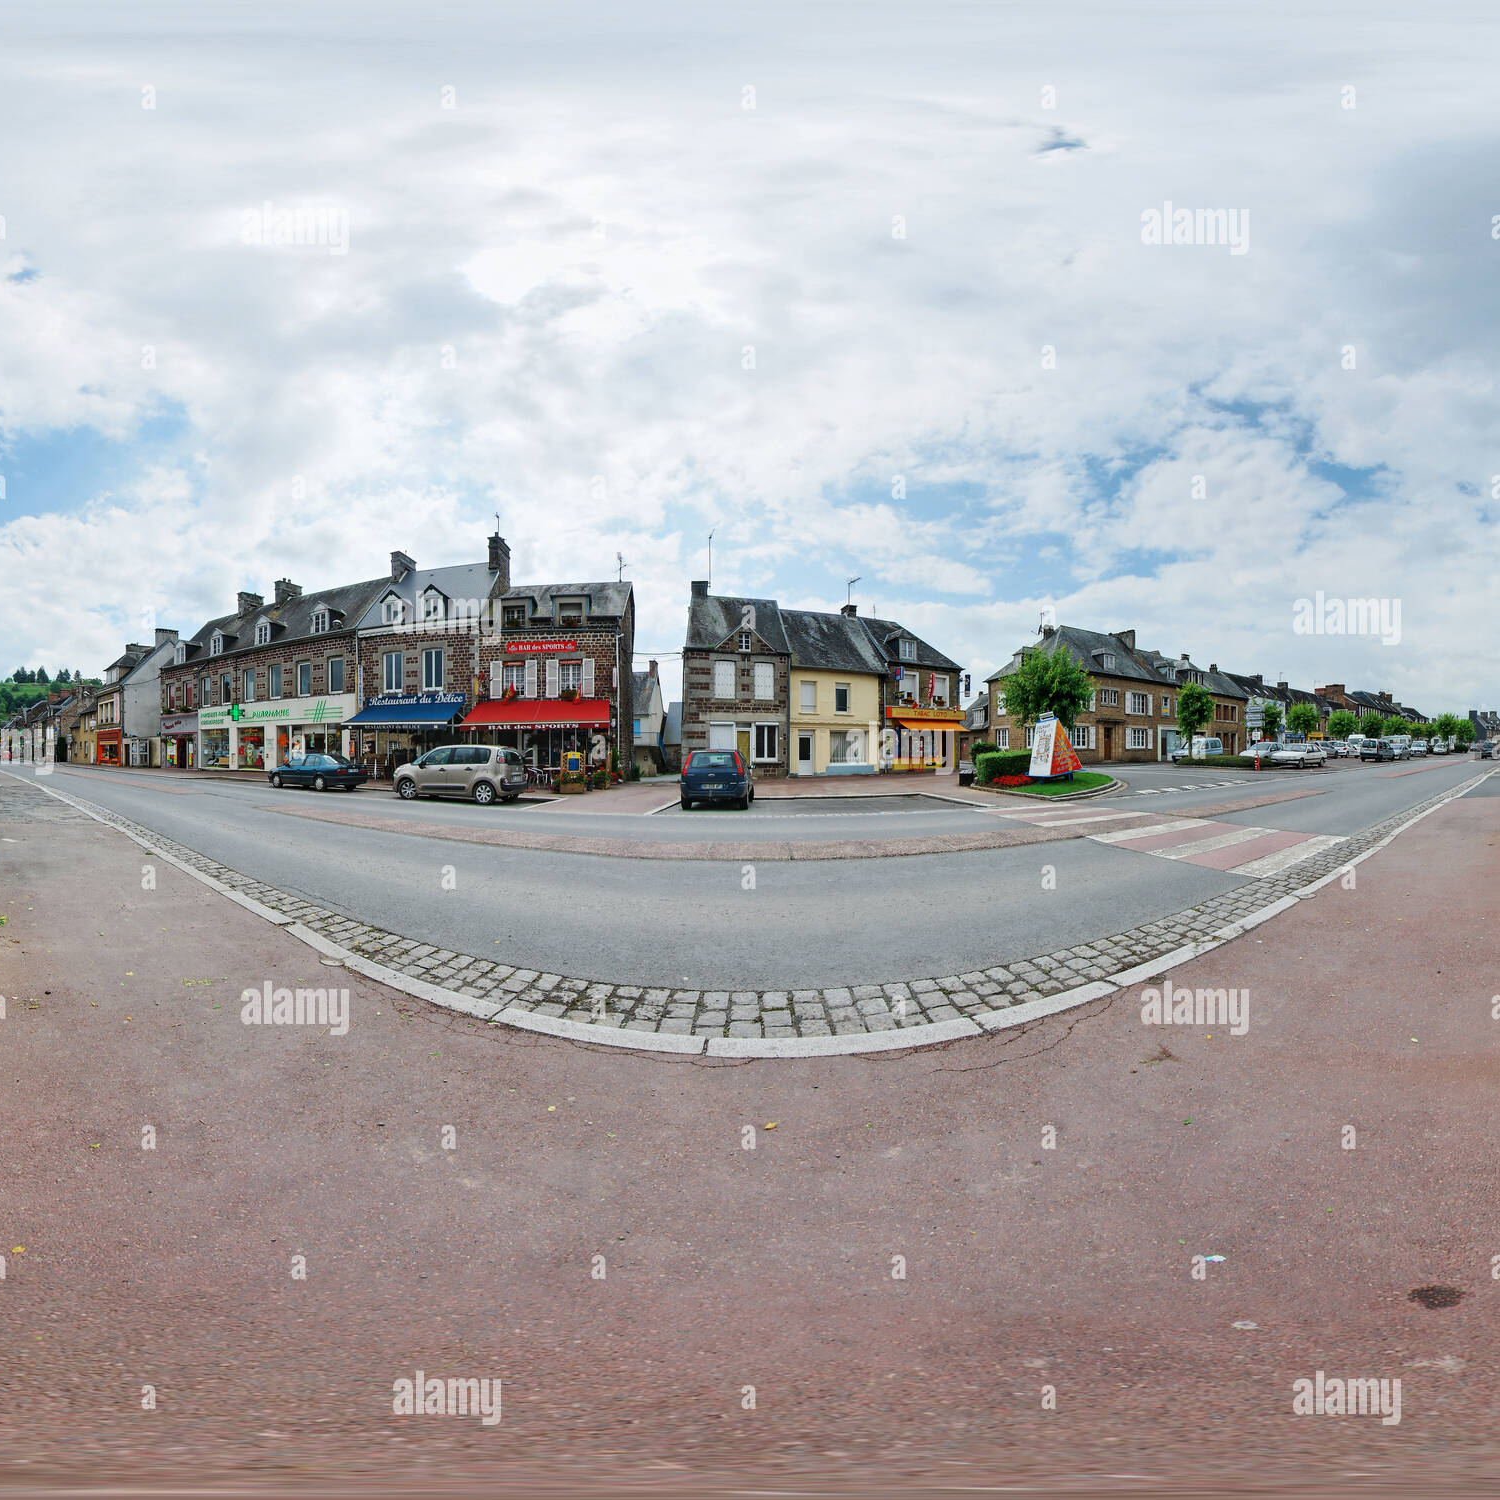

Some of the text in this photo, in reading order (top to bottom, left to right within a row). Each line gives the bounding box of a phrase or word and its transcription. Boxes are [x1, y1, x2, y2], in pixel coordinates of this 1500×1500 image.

[368, 692, 464, 706] Restaurant du Délice
[251, 708, 290, 719] PHARMACIE
